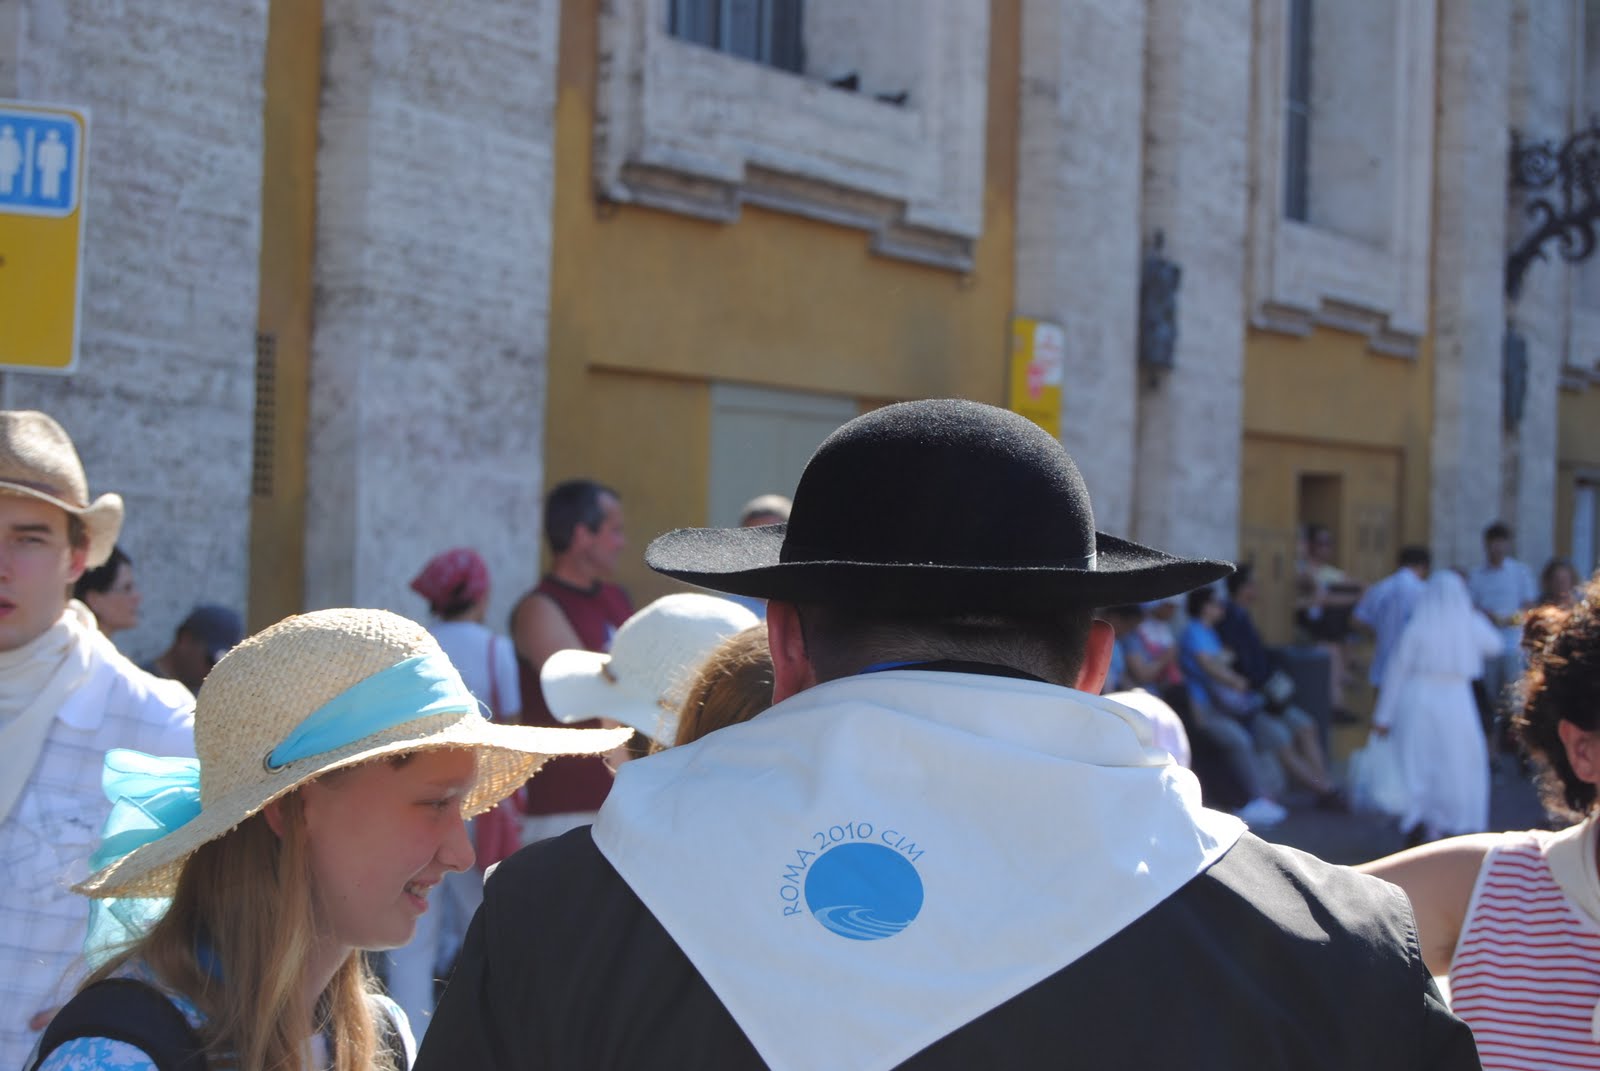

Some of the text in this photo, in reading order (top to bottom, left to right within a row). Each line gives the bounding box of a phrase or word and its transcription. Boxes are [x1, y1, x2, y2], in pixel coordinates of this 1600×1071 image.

[780, 822, 925, 917] ROMA 2010 CIM
